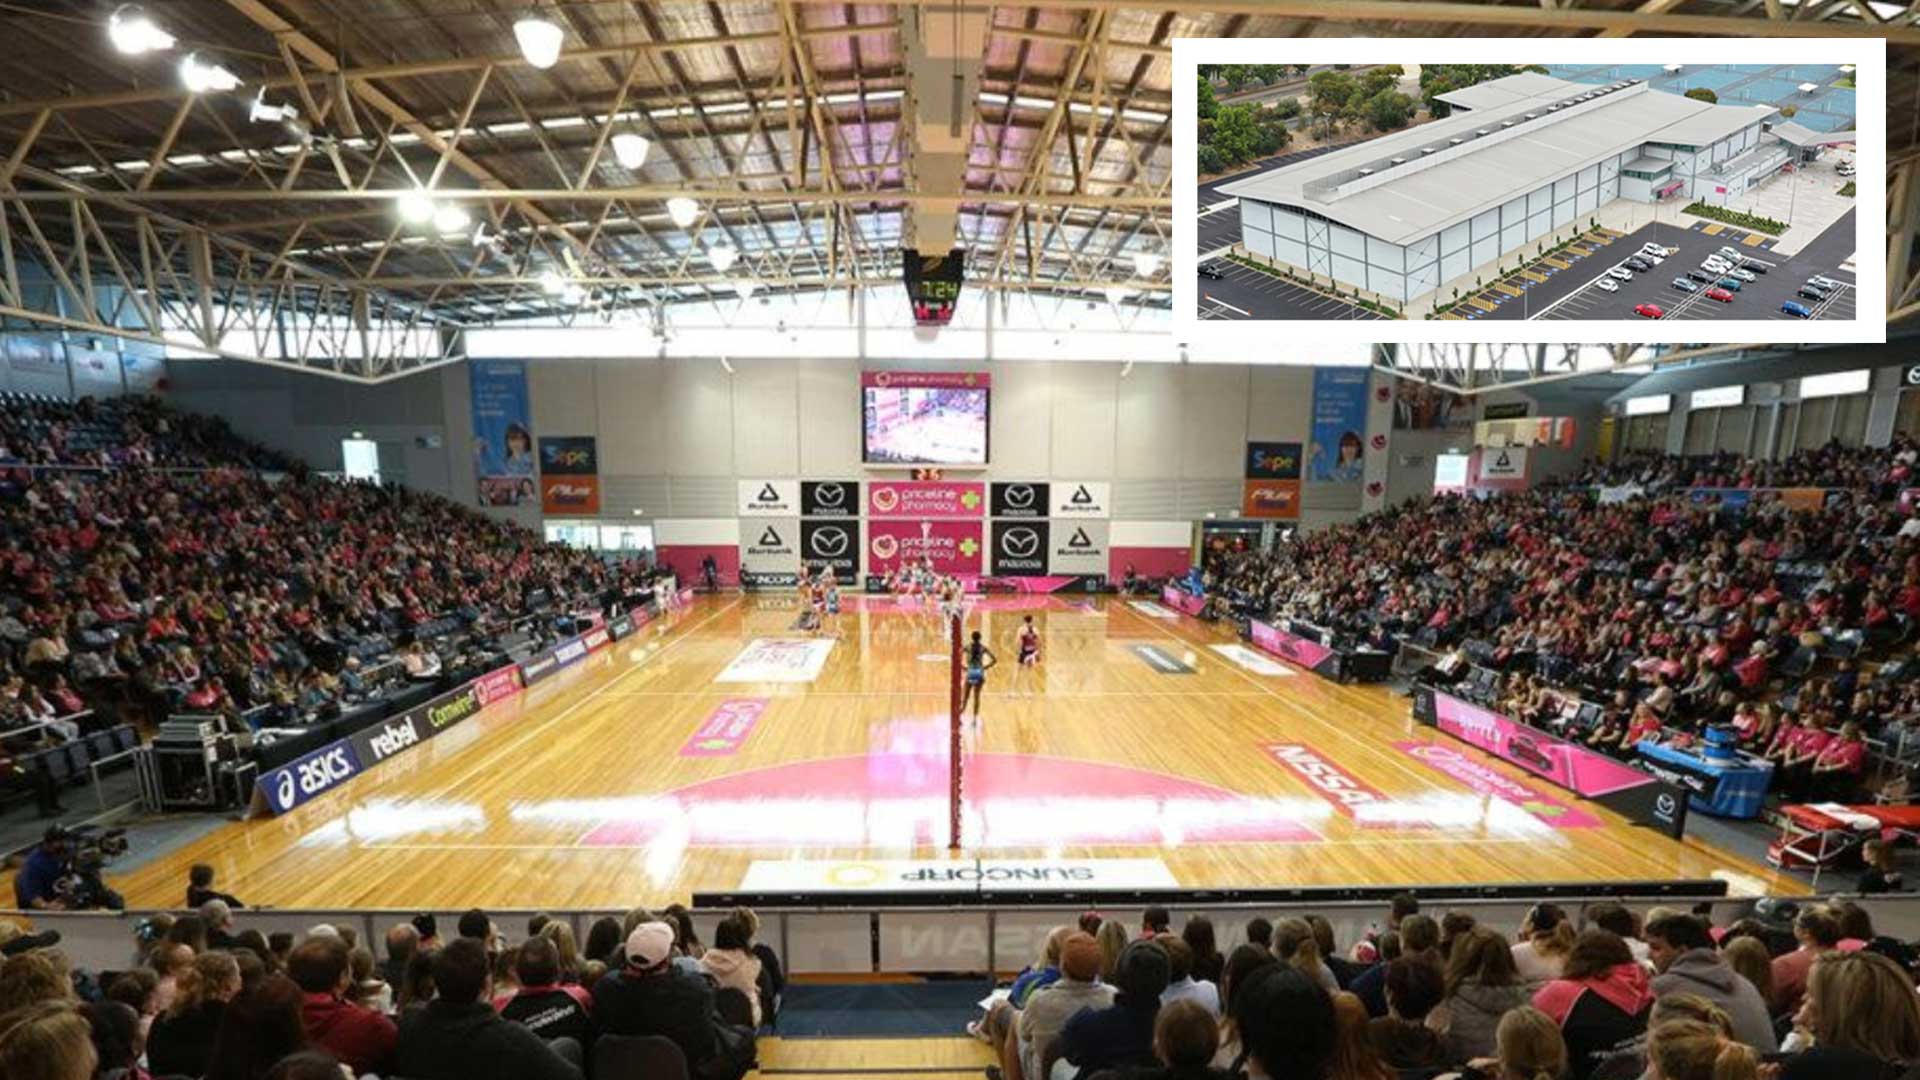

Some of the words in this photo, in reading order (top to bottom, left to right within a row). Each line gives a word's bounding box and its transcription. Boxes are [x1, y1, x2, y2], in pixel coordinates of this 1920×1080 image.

[901, 489, 957, 499] priceline
[901, 500, 957, 512] pharmacy
[998, 560, 1042, 568] mazda
[369, 715, 419, 759] rebel
[298, 747, 351, 794] asics
[901, 867, 1095, 881] SUNCORP
